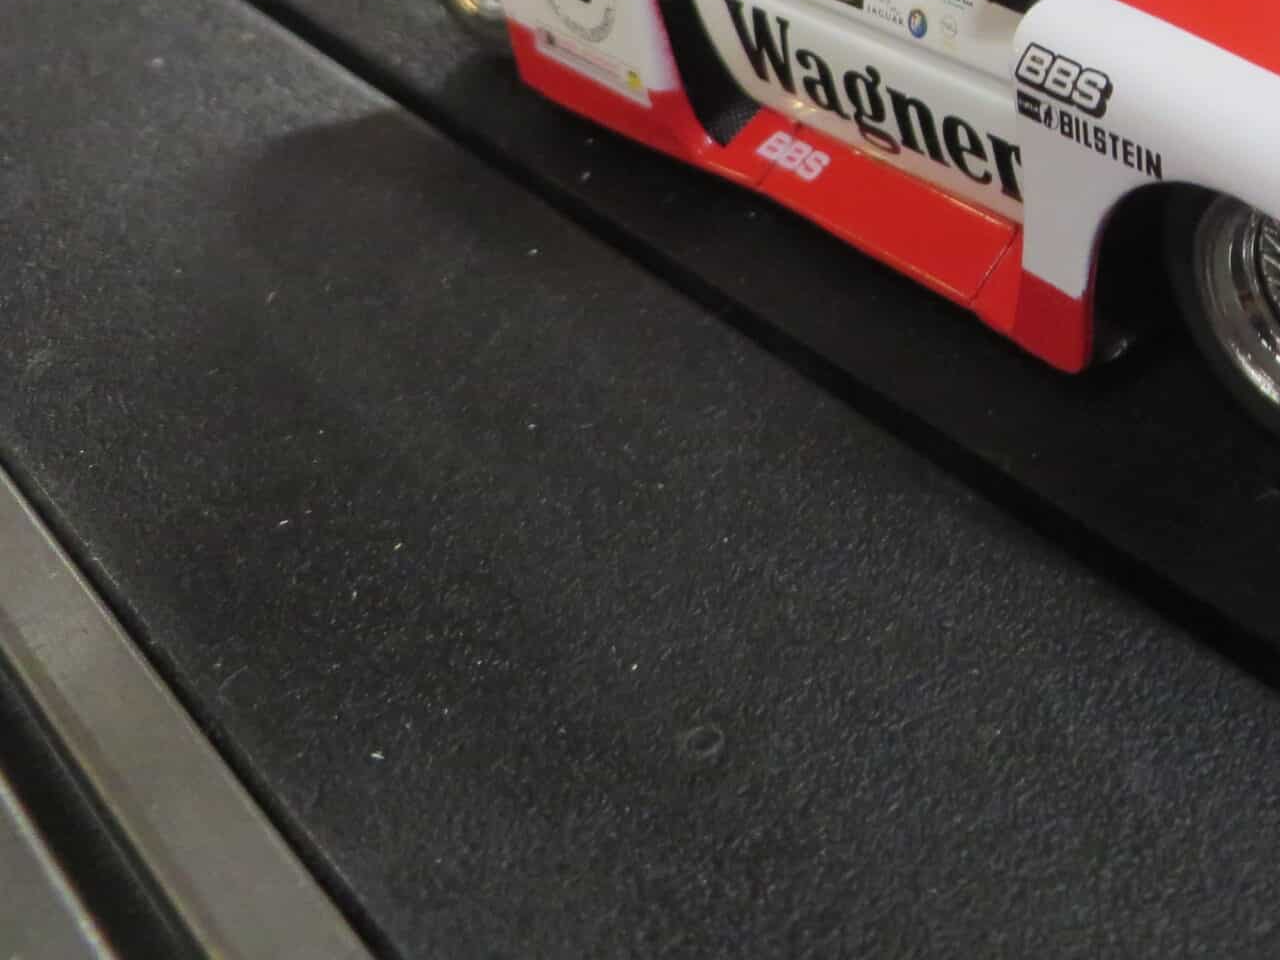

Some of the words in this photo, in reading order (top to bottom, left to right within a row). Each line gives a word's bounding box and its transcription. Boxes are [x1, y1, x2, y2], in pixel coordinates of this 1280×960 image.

[1014, 42, 1114, 118] BBS
[756, 131, 832, 182] BBS
[1059, 109, 1163, 181] BILSTEIN
